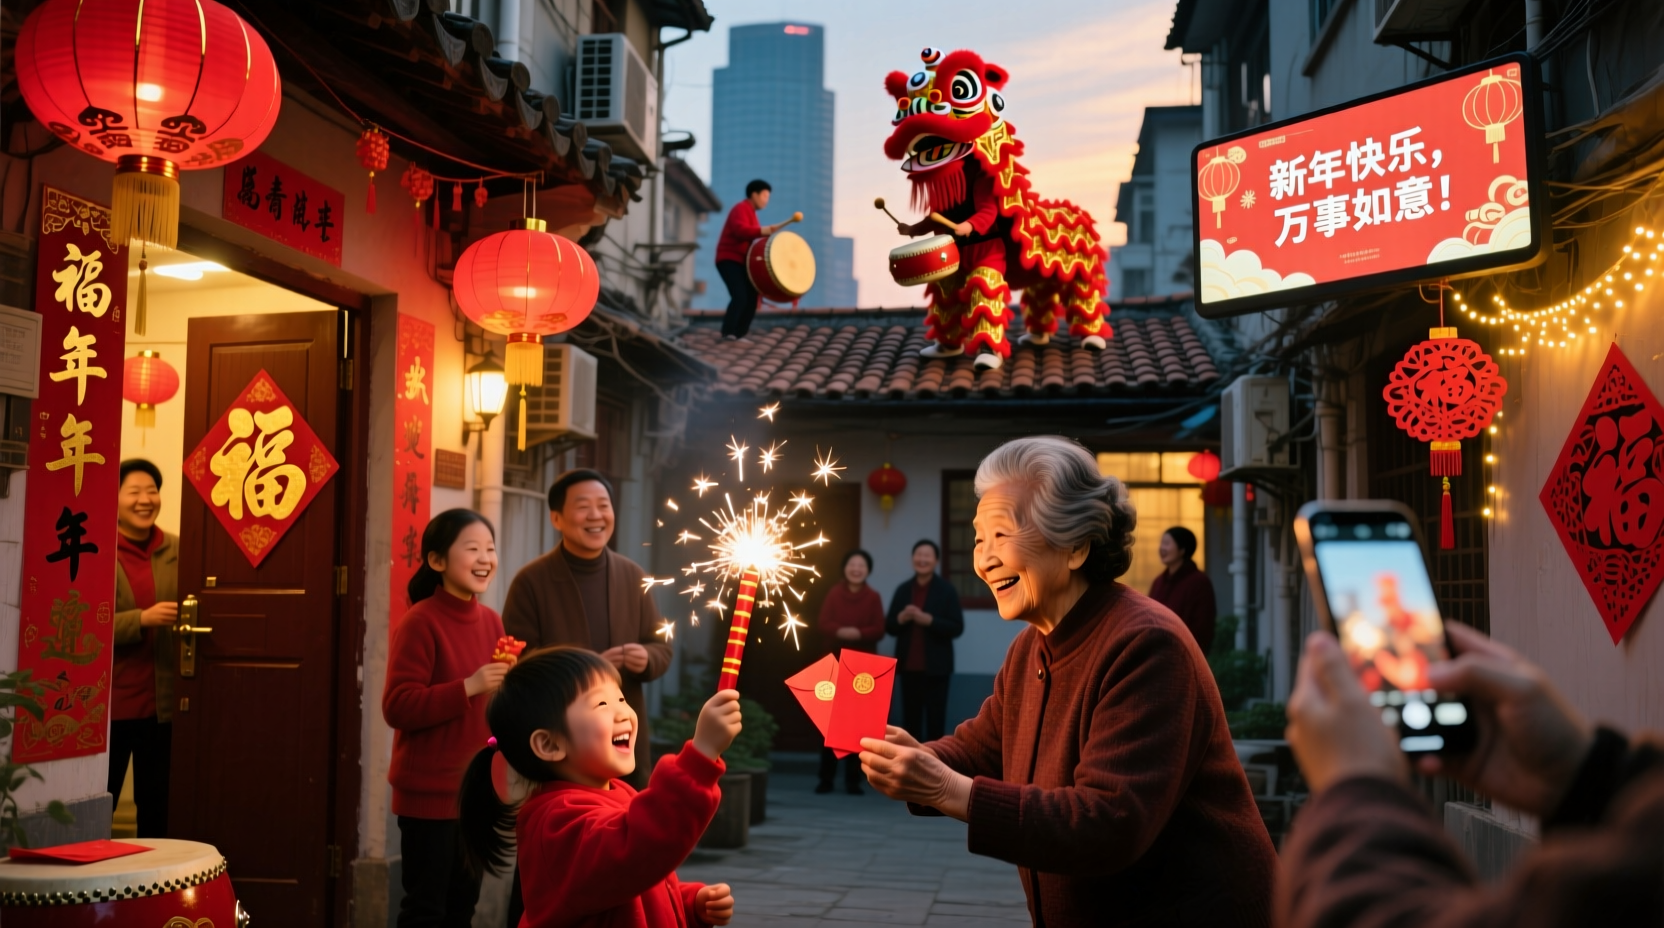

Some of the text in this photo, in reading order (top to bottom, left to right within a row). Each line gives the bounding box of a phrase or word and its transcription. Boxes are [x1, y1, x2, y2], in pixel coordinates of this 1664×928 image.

[1269, 126, 1443, 200] 新年快乐，
[1274, 174, 1451, 248] 万事如意！
[210, 405, 307, 521] 福
[1582, 410, 1664, 549] 福
